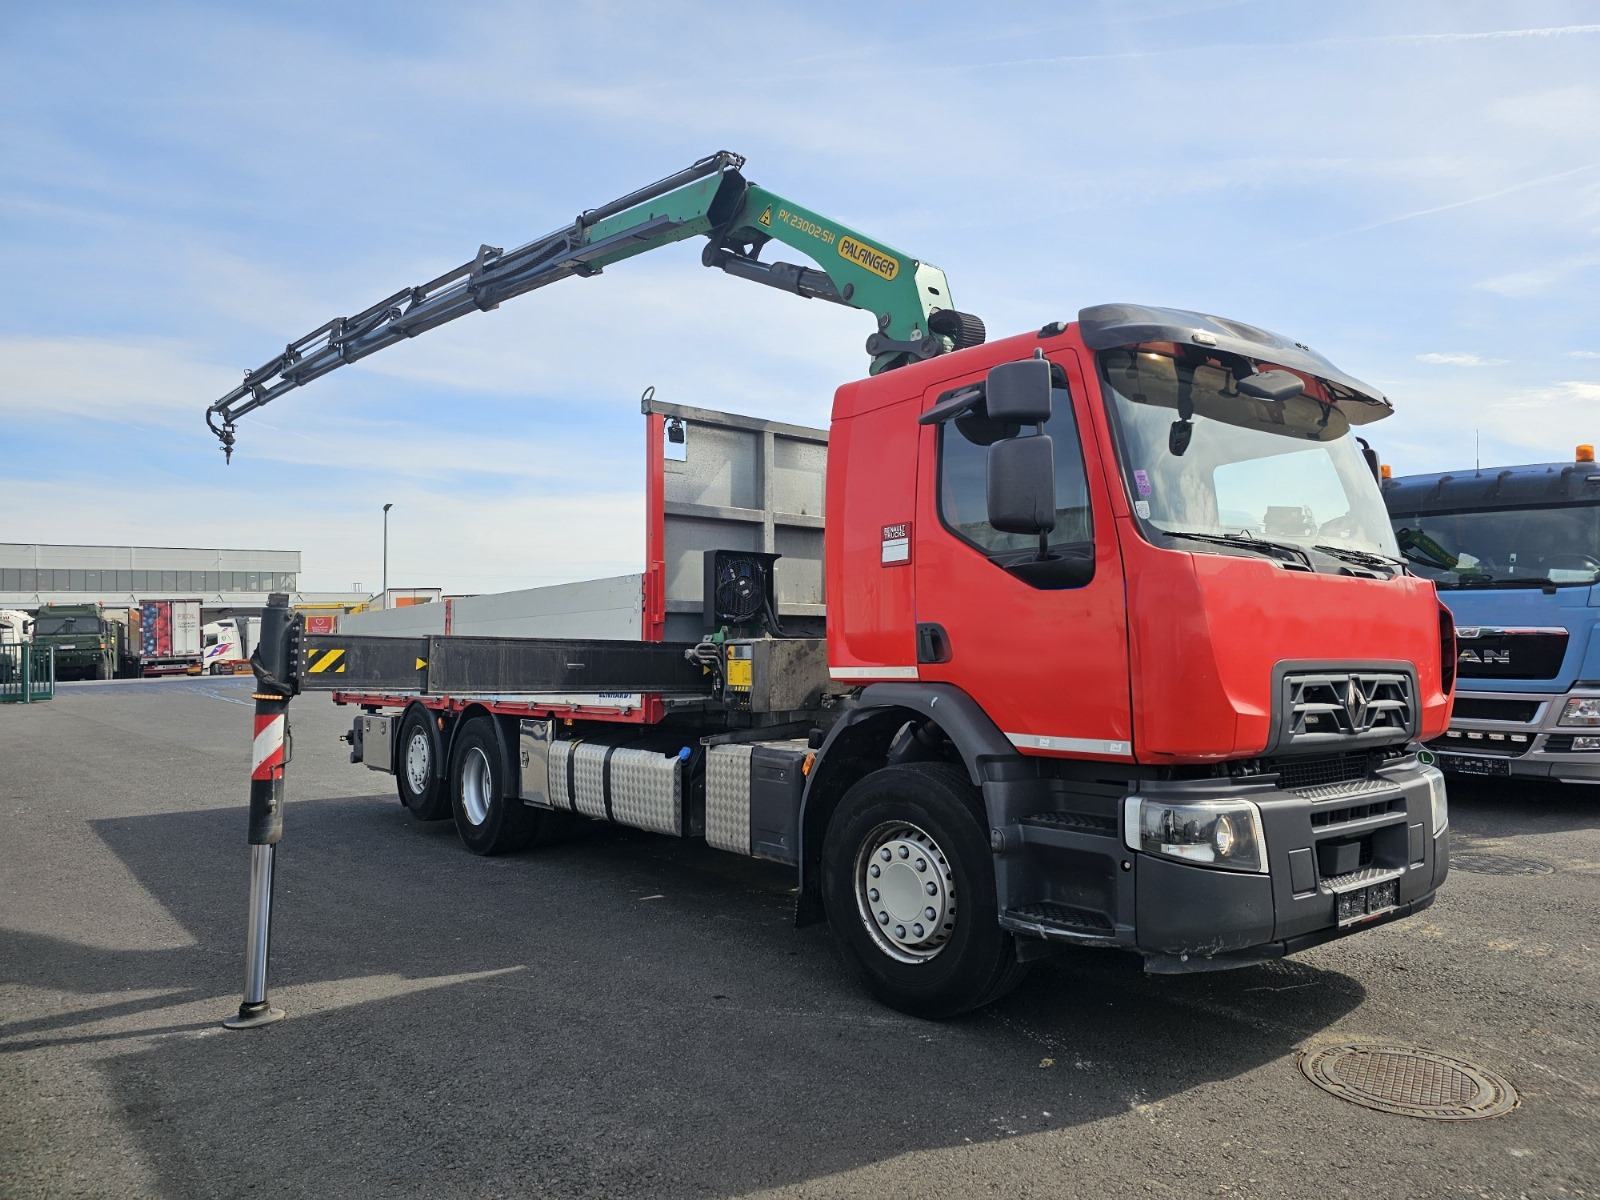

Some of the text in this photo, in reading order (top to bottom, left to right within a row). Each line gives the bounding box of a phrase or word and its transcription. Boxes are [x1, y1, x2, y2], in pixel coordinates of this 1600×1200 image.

[778, 208, 791, 223] PK
[840, 239, 897, 277] PALFINGER
[883, 530, 906, 541] TRUCKS
[1457, 649, 1510, 664] AN
[1421, 752, 1430, 763] L
